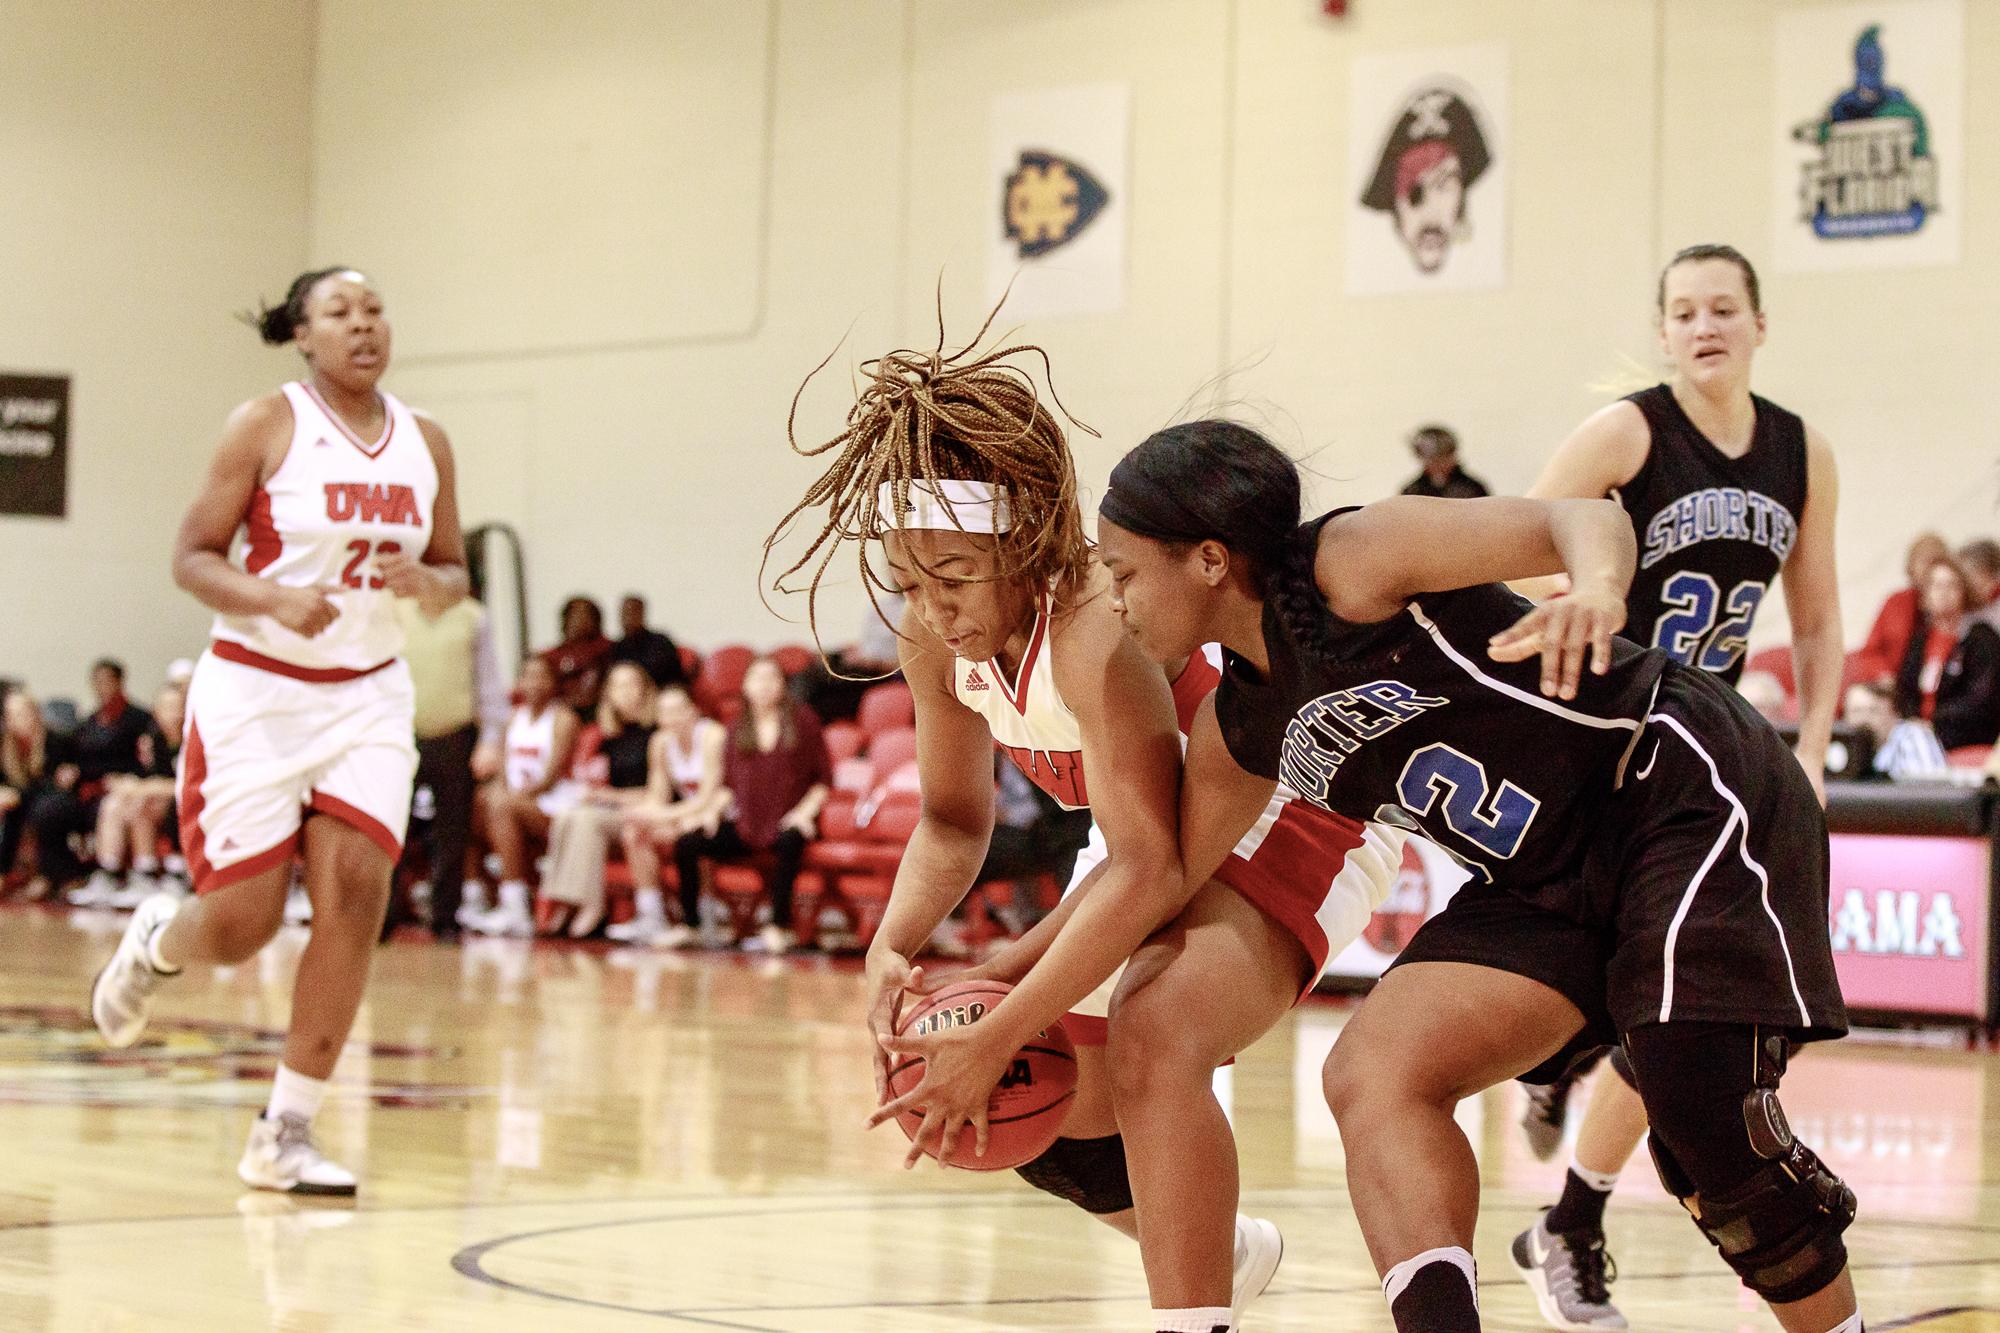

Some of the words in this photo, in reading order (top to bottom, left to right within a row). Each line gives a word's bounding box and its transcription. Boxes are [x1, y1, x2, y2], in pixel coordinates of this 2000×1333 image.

[323, 482, 423, 528] UWA
[1640, 487, 1798, 569] SHORTE
[1650, 570, 1766, 673] 22
[965, 682, 990, 692] adidas
[1396, 741, 1541, 859] 2
[1829, 888, 1966, 960] AMA
